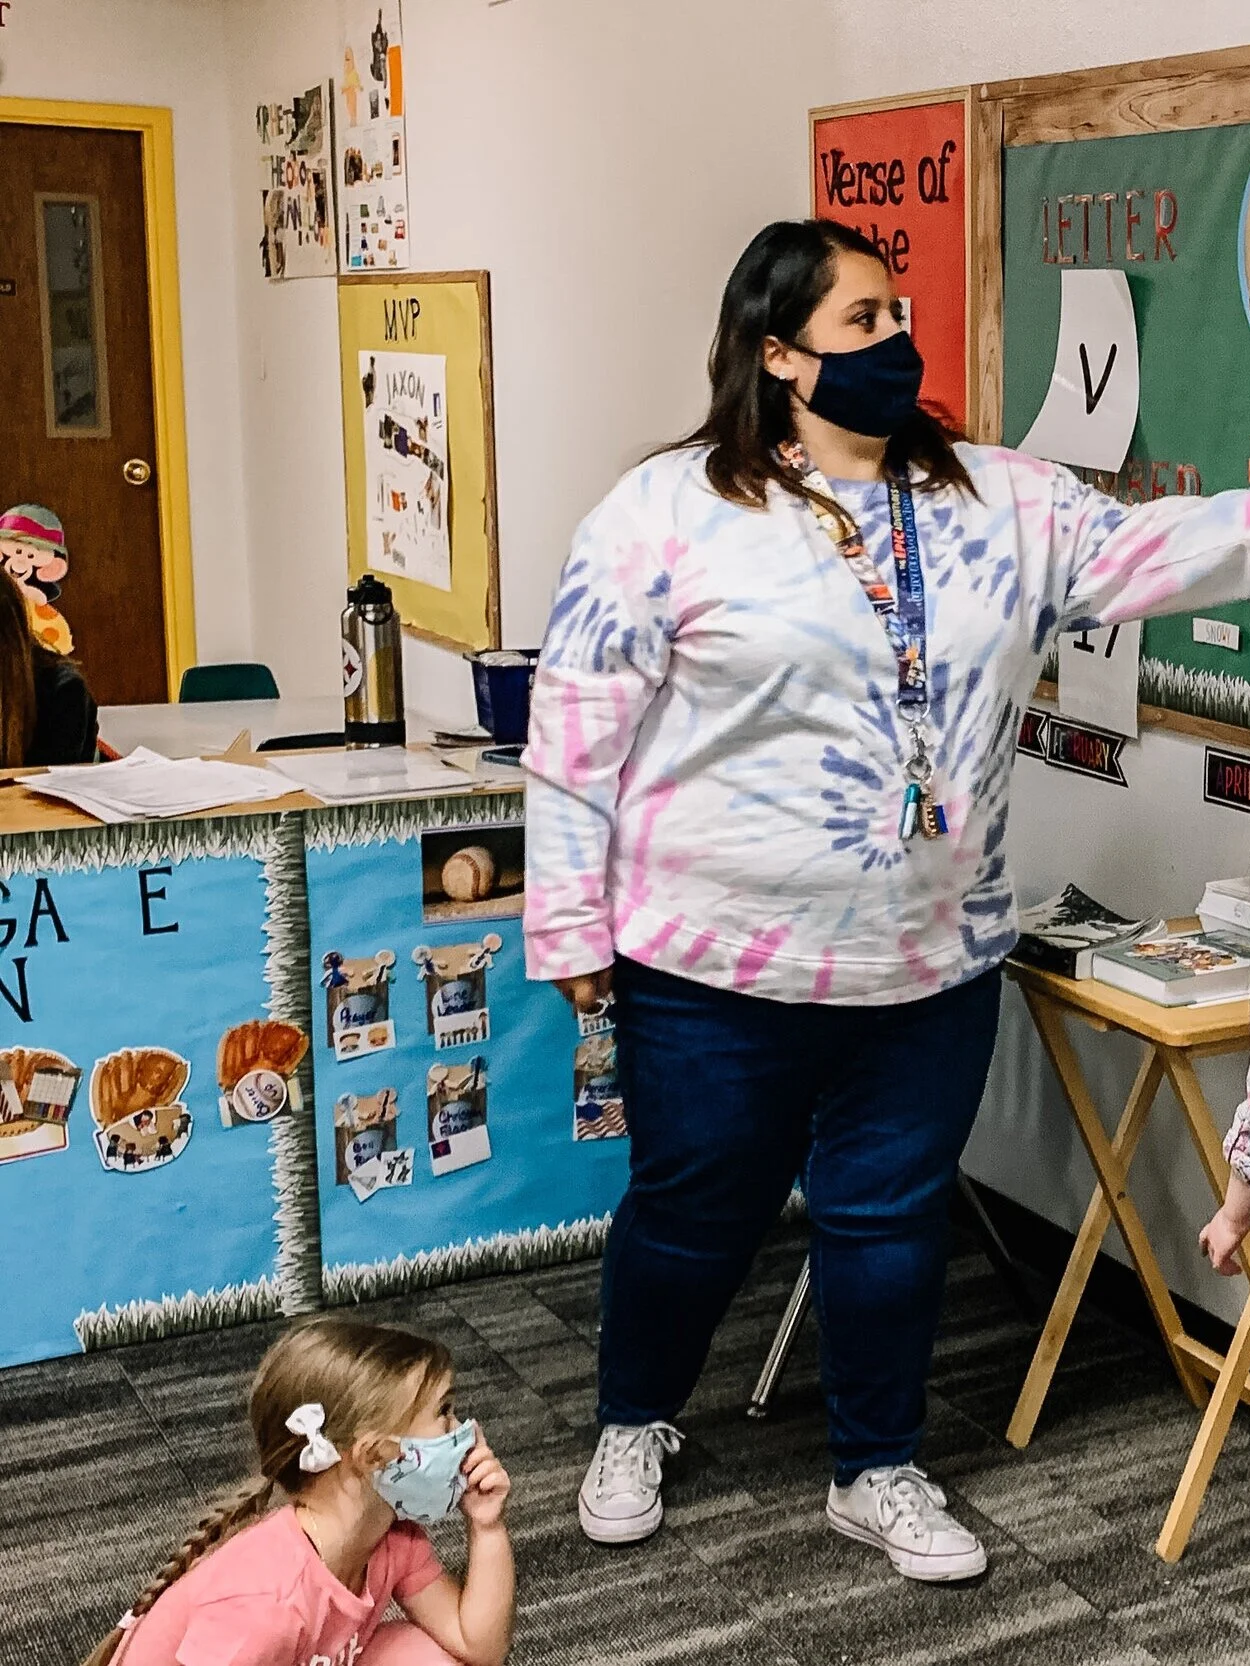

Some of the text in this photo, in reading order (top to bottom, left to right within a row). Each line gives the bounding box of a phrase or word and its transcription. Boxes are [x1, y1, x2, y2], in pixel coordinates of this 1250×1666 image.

[820, 139, 957, 207] Verse of
[855, 223, 911, 275] he
[1042, 188, 1178, 264] LETTER
[383, 297, 421, 341] MVP
[386, 369, 426, 408] JAXON
[1078, 341, 1117, 415] V
[891, 529, 906, 560] EPIC
[1205, 623, 1232, 644] SNOWY
